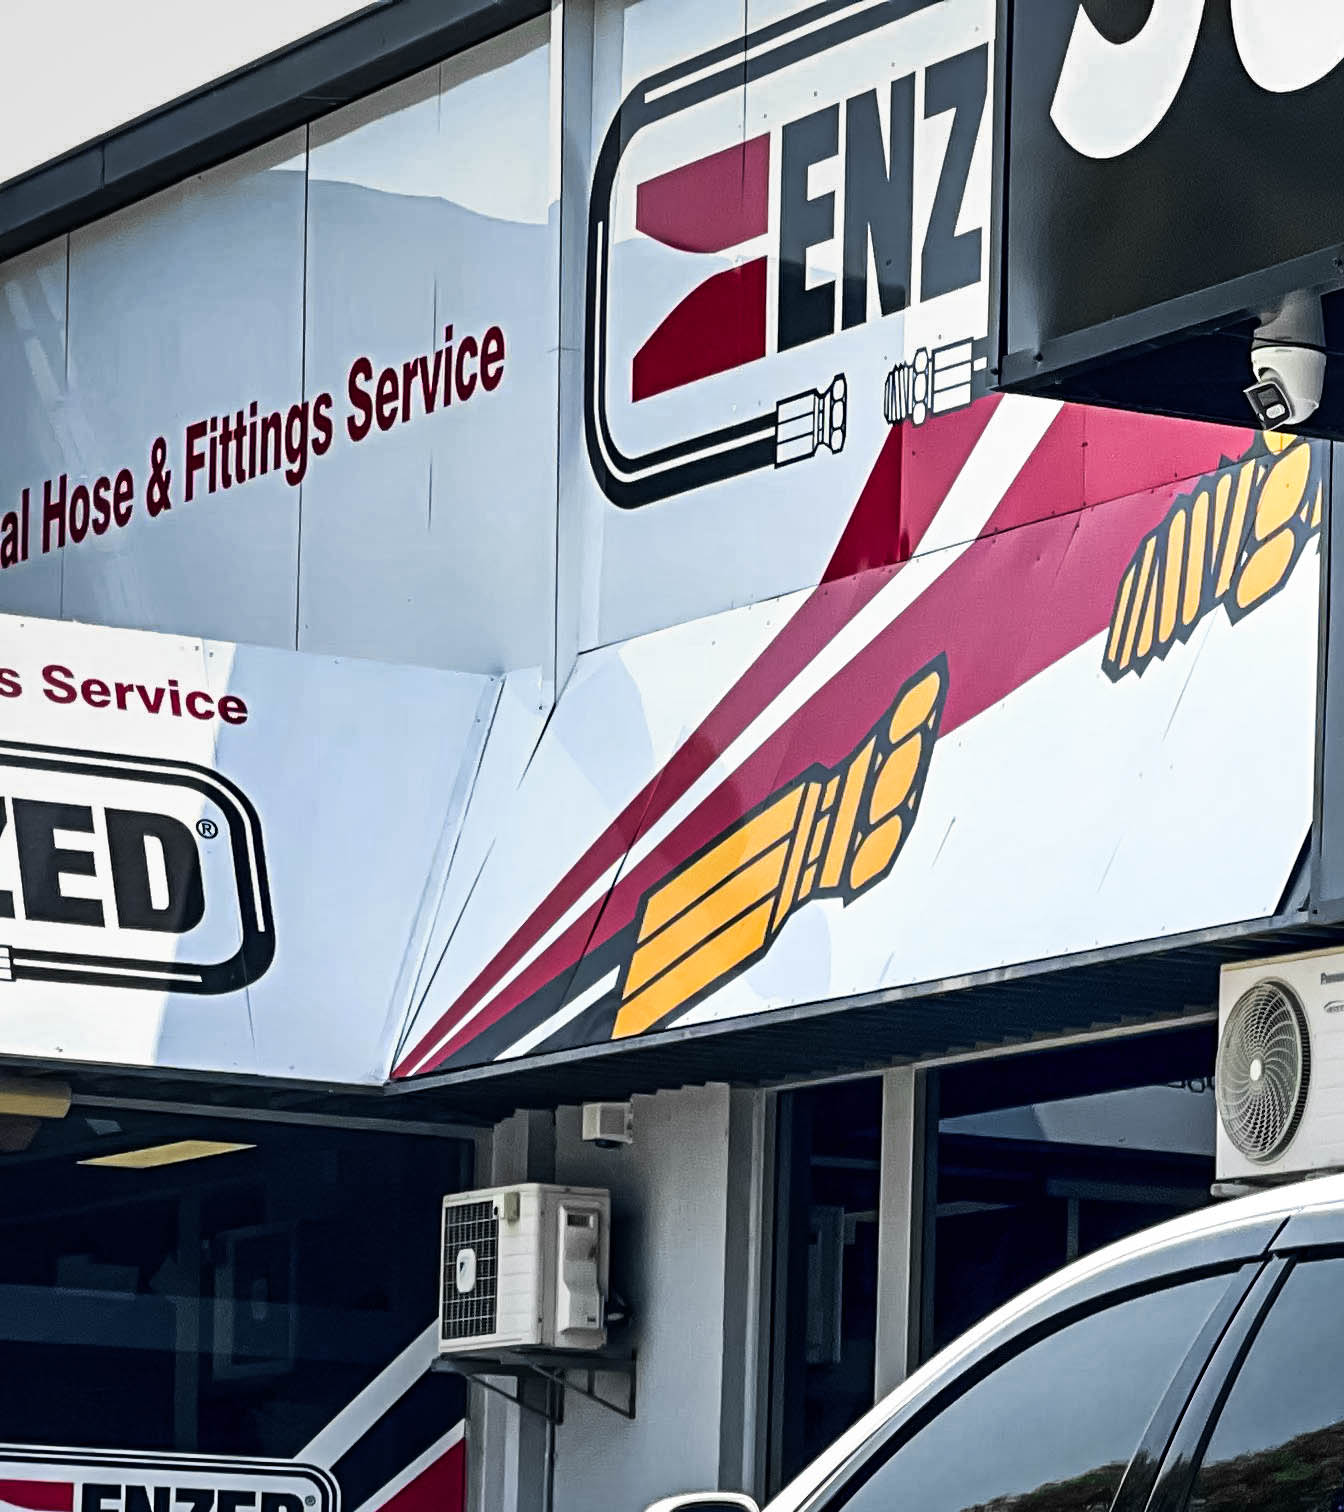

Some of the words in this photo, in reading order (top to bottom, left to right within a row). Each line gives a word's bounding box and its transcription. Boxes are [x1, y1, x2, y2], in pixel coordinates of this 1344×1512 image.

[42, 468, 134, 554] Hose
[147, 437, 171, 517] &
[184, 393, 333, 503] Fittings
[346, 324, 505, 442] Service
[42, 664, 248, 725] Service
